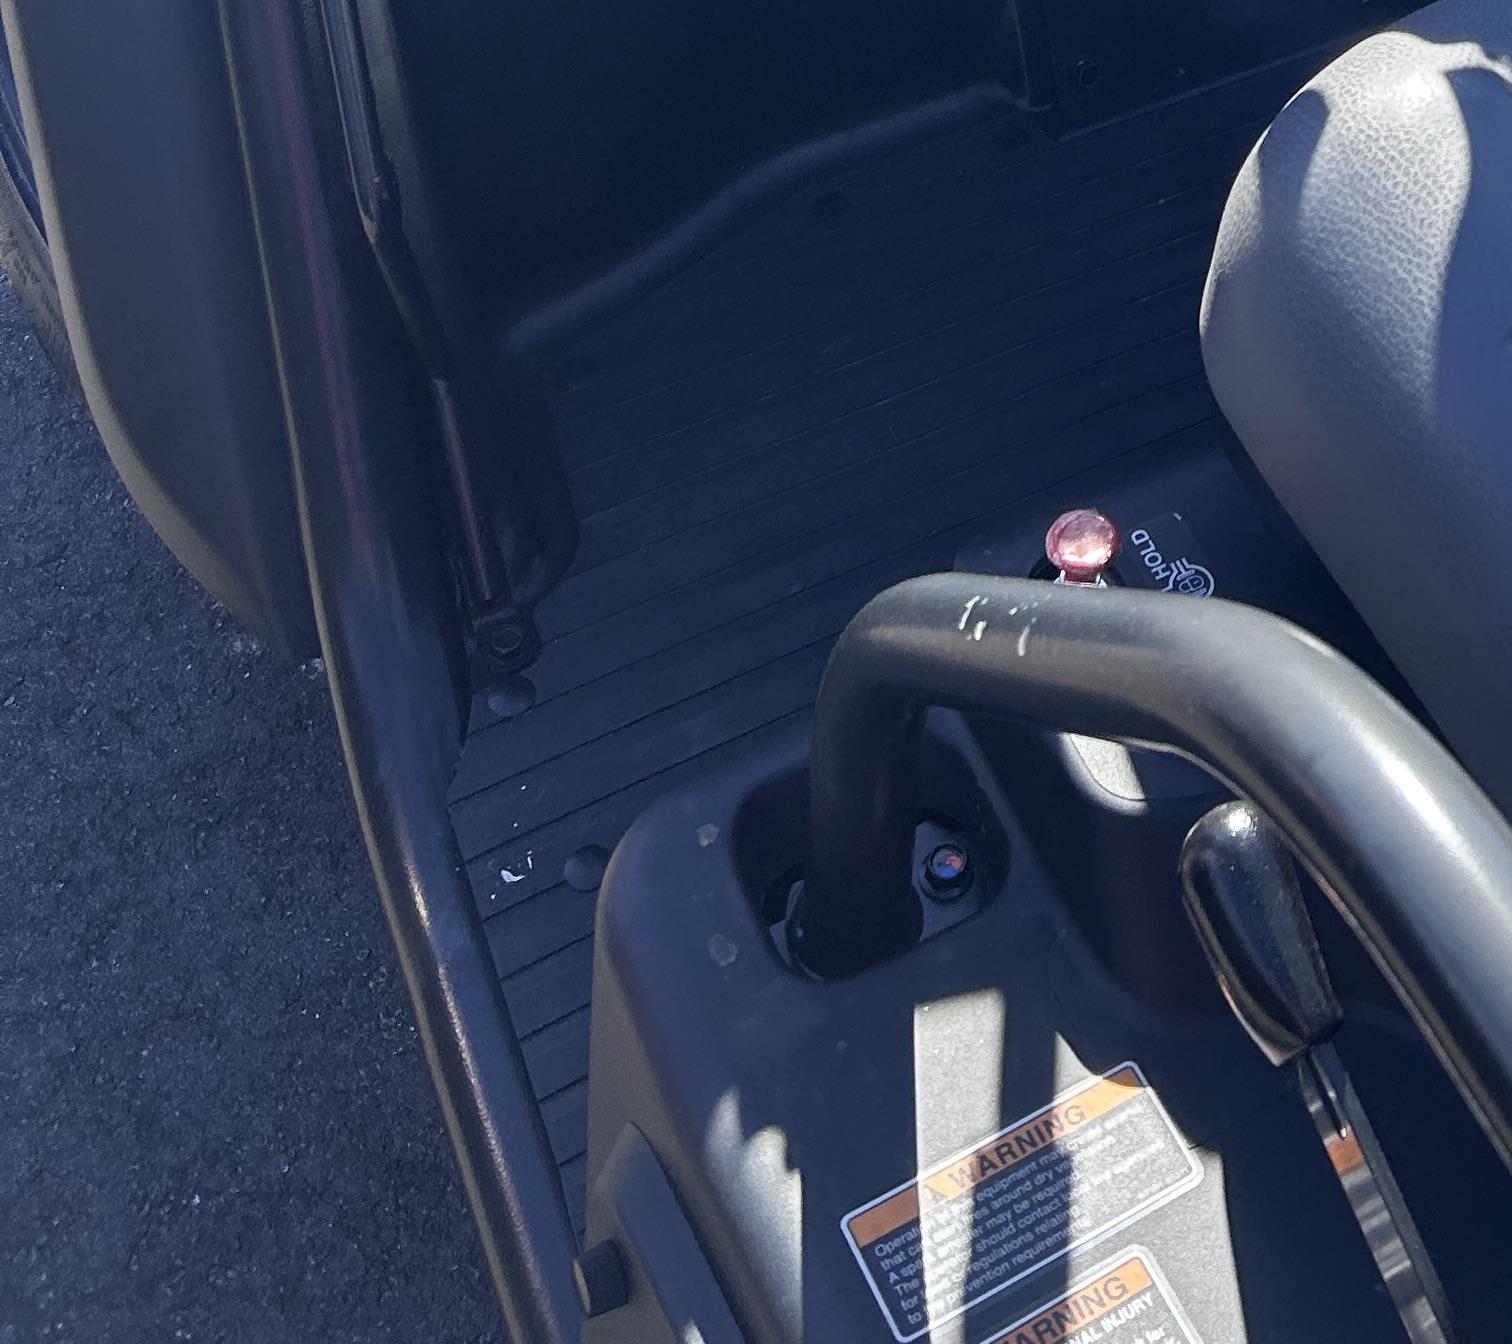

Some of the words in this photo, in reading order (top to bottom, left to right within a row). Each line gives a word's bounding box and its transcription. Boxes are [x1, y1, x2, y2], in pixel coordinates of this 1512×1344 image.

[1131, 529, 1172, 581] HOLD
[947, 1101, 1089, 1190] WARNING
[974, 1161, 1041, 1204] equipment
[1037, 1145, 1066, 1168] may
[879, 1249, 908, 1271] that
[988, 1180, 1034, 1211] around
[1031, 1168, 1056, 1188] dry
[886, 1269, 900, 1283] A
[899, 1252, 936, 1278] spa
[985, 1209, 1014, 1231] may
[1012, 1198, 1032, 1214] be
[893, 1275, 921, 1297] The
[973, 1222, 1017, 1253] should
[1014, 1198, 1062, 1229] contact
[900, 1293, 920, 1311] for
[965, 1230, 1036, 1276] regulations
[907, 1310, 922, 1325] to
[1000, 1276, 1129, 1344] ARNING
[1101, 1292, 1154, 1333] INJURY
